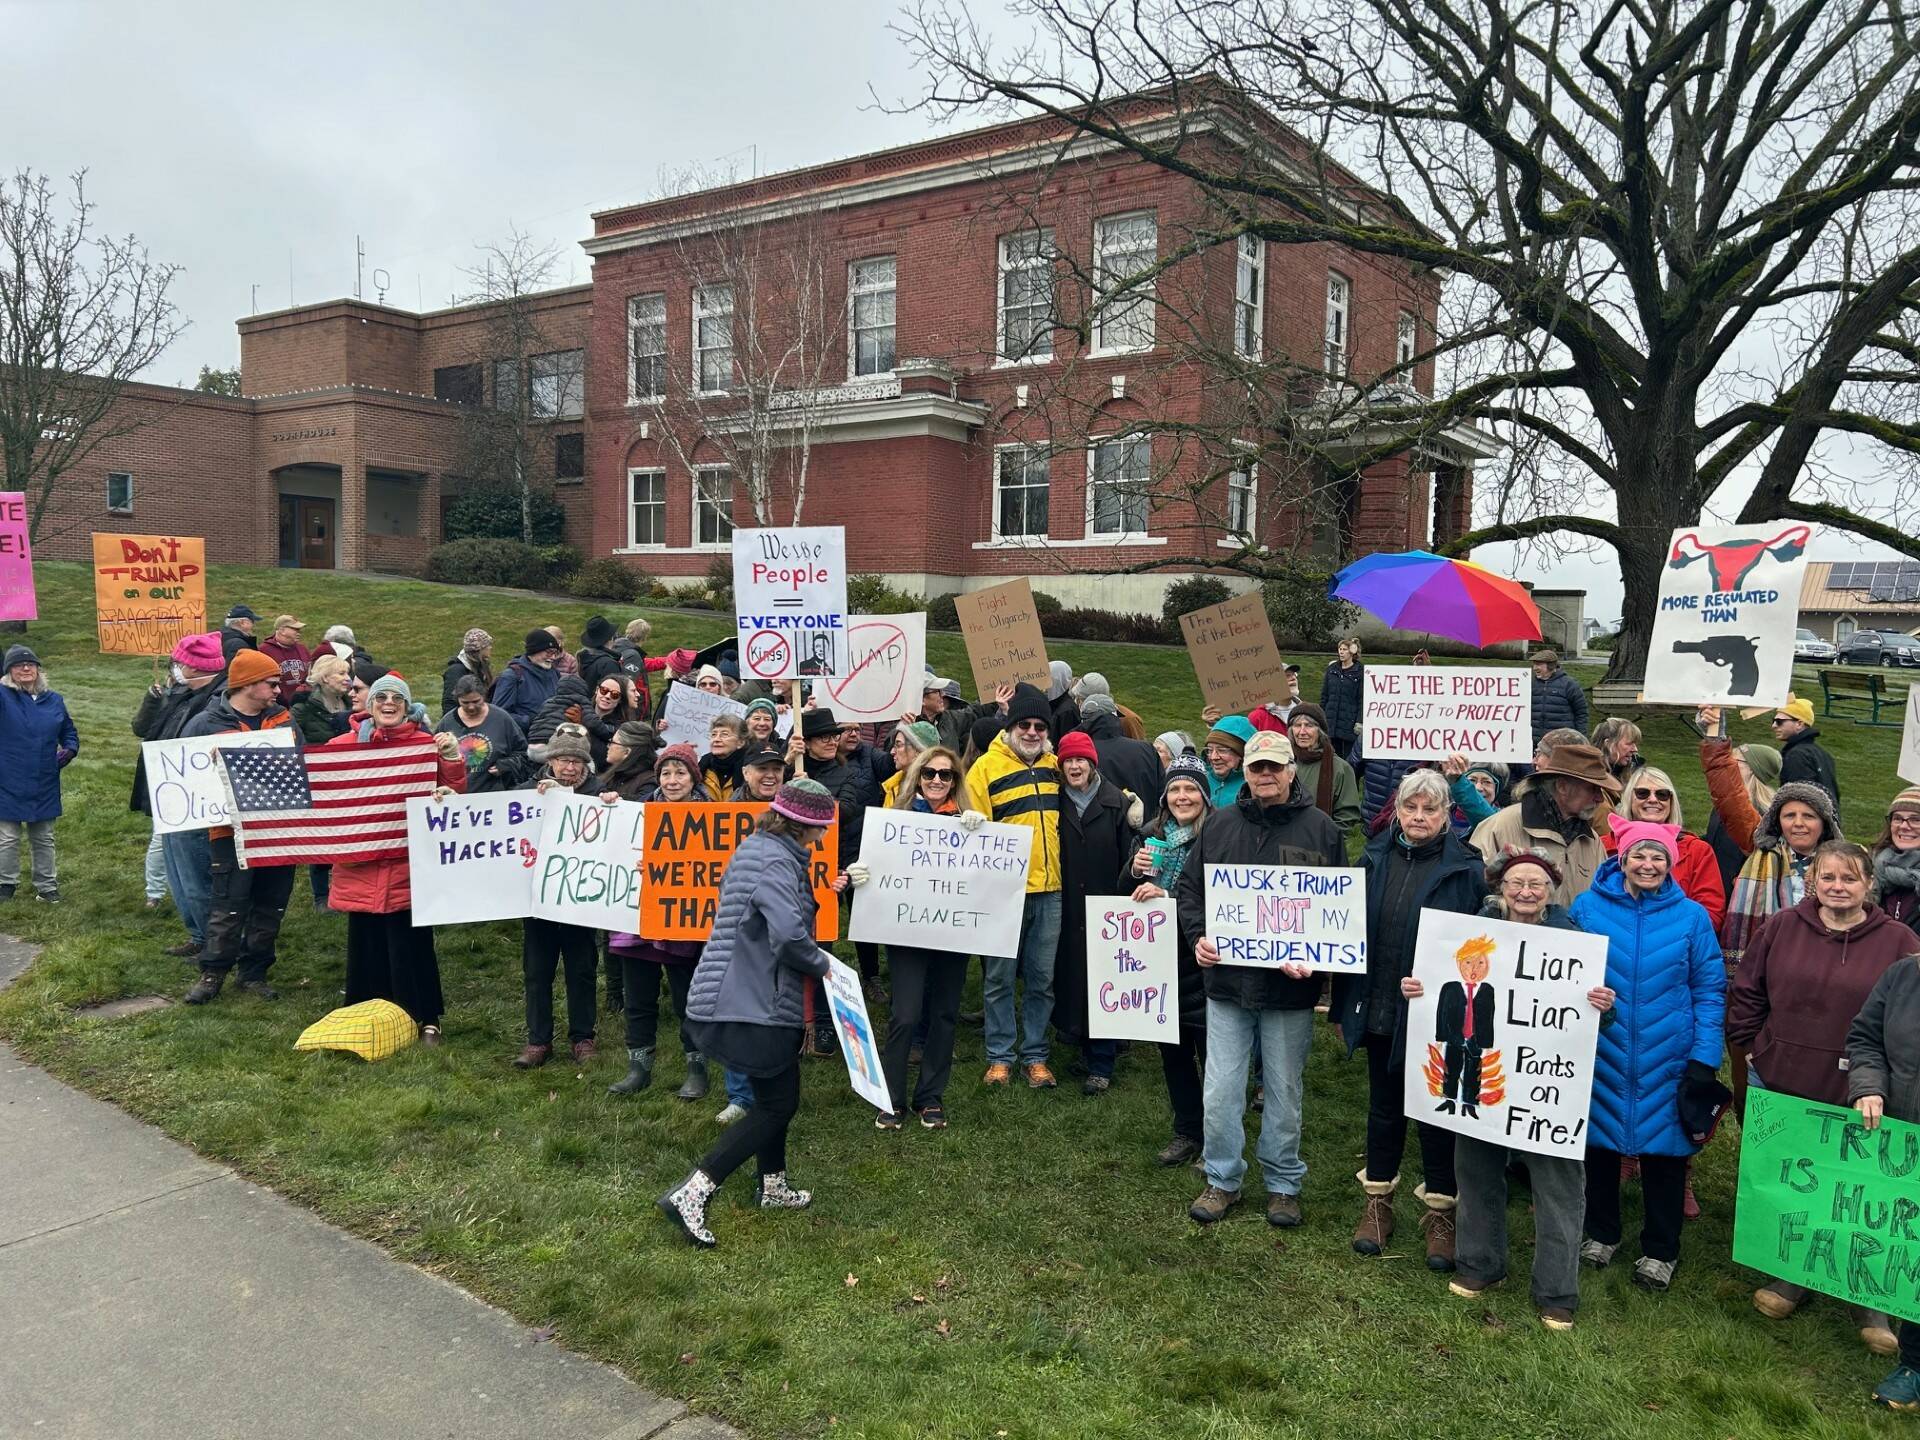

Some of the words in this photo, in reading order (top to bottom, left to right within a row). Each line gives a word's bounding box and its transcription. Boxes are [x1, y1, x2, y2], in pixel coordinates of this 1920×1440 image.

[0, 501, 24, 521] TE
[0, 534, 25, 559] E!
[120, 538, 181, 563] Don't
[99, 564, 199, 582] TRUMP
[752, 563, 828, 591] People
[977, 593, 1007, 613] Fight
[1661, 595, 1699, 611] MORE
[1704, 590, 1779, 608] REGULATED
[738, 614, 843, 629] EVERYONE
[969, 623, 985, 634] the
[989, 610, 1032, 629] Oligarchy
[1185, 614, 1213, 629] The
[1218, 604, 1254, 620] Power
[1701, 608, 1738, 623] THAN
[993, 638, 1015, 650] Fire
[1195, 631, 1208, 646] of
[1209, 628, 1228, 641] the
[1228, 620, 1261, 636] People
[851, 643, 901, 673] UMP
[981, 657, 1006, 670] Elon
[1008, 647, 1038, 663] Musk
[1216, 652, 1227, 665] is
[1229, 644, 1265, 660] stronger
[1207, 677, 1230, 691] than
[1231, 670, 1248, 682] the
[1253, 665, 1281, 682] people
[1407, 675, 1445, 696] THE
[1241, 687, 1273, 705] Power
[1366, 702, 1434, 719] PROTEST
[1456, 703, 1525, 722] PROTECT
[425, 804, 493, 832] WE'VE
[508, 801, 546, 826] BEE
[556, 804, 618, 845] NOT
[884, 821, 970, 848] DESTROY
[978, 834, 1018, 853] THE
[648, 861, 722, 886] WE'RE
[911, 849, 1028, 877] PATRIARCHY
[540, 854, 640, 910] PRESIDE
[879, 874, 912, 890] NOT
[928, 879, 968, 895] THE
[1212, 869, 1275, 891] MUSK
[1293, 871, 1352, 896] TRUMP
[659, 898, 717, 929] THA
[897, 903, 991, 928] PLANET
[1101, 910, 1167, 942] STOP
[1215, 904, 1250, 923] ARE
[1256, 895, 1311, 934] NOT
[1322, 908, 1350, 931] MY
[1114, 948, 1147, 973] the
[1215, 936, 1366, 965] PRESIDENTS!
[1515, 1045, 1575, 1078] Pants
[1530, 1085, 1560, 1105] on
[1506, 1105, 1585, 1145] Fire!
[1805, 1108, 1920, 1182] TRU
[1780, 1158, 1819, 1193] IS
[1831, 1181, 1920, 1241] HUR
[1778, 1211, 1920, 1303] FARM
